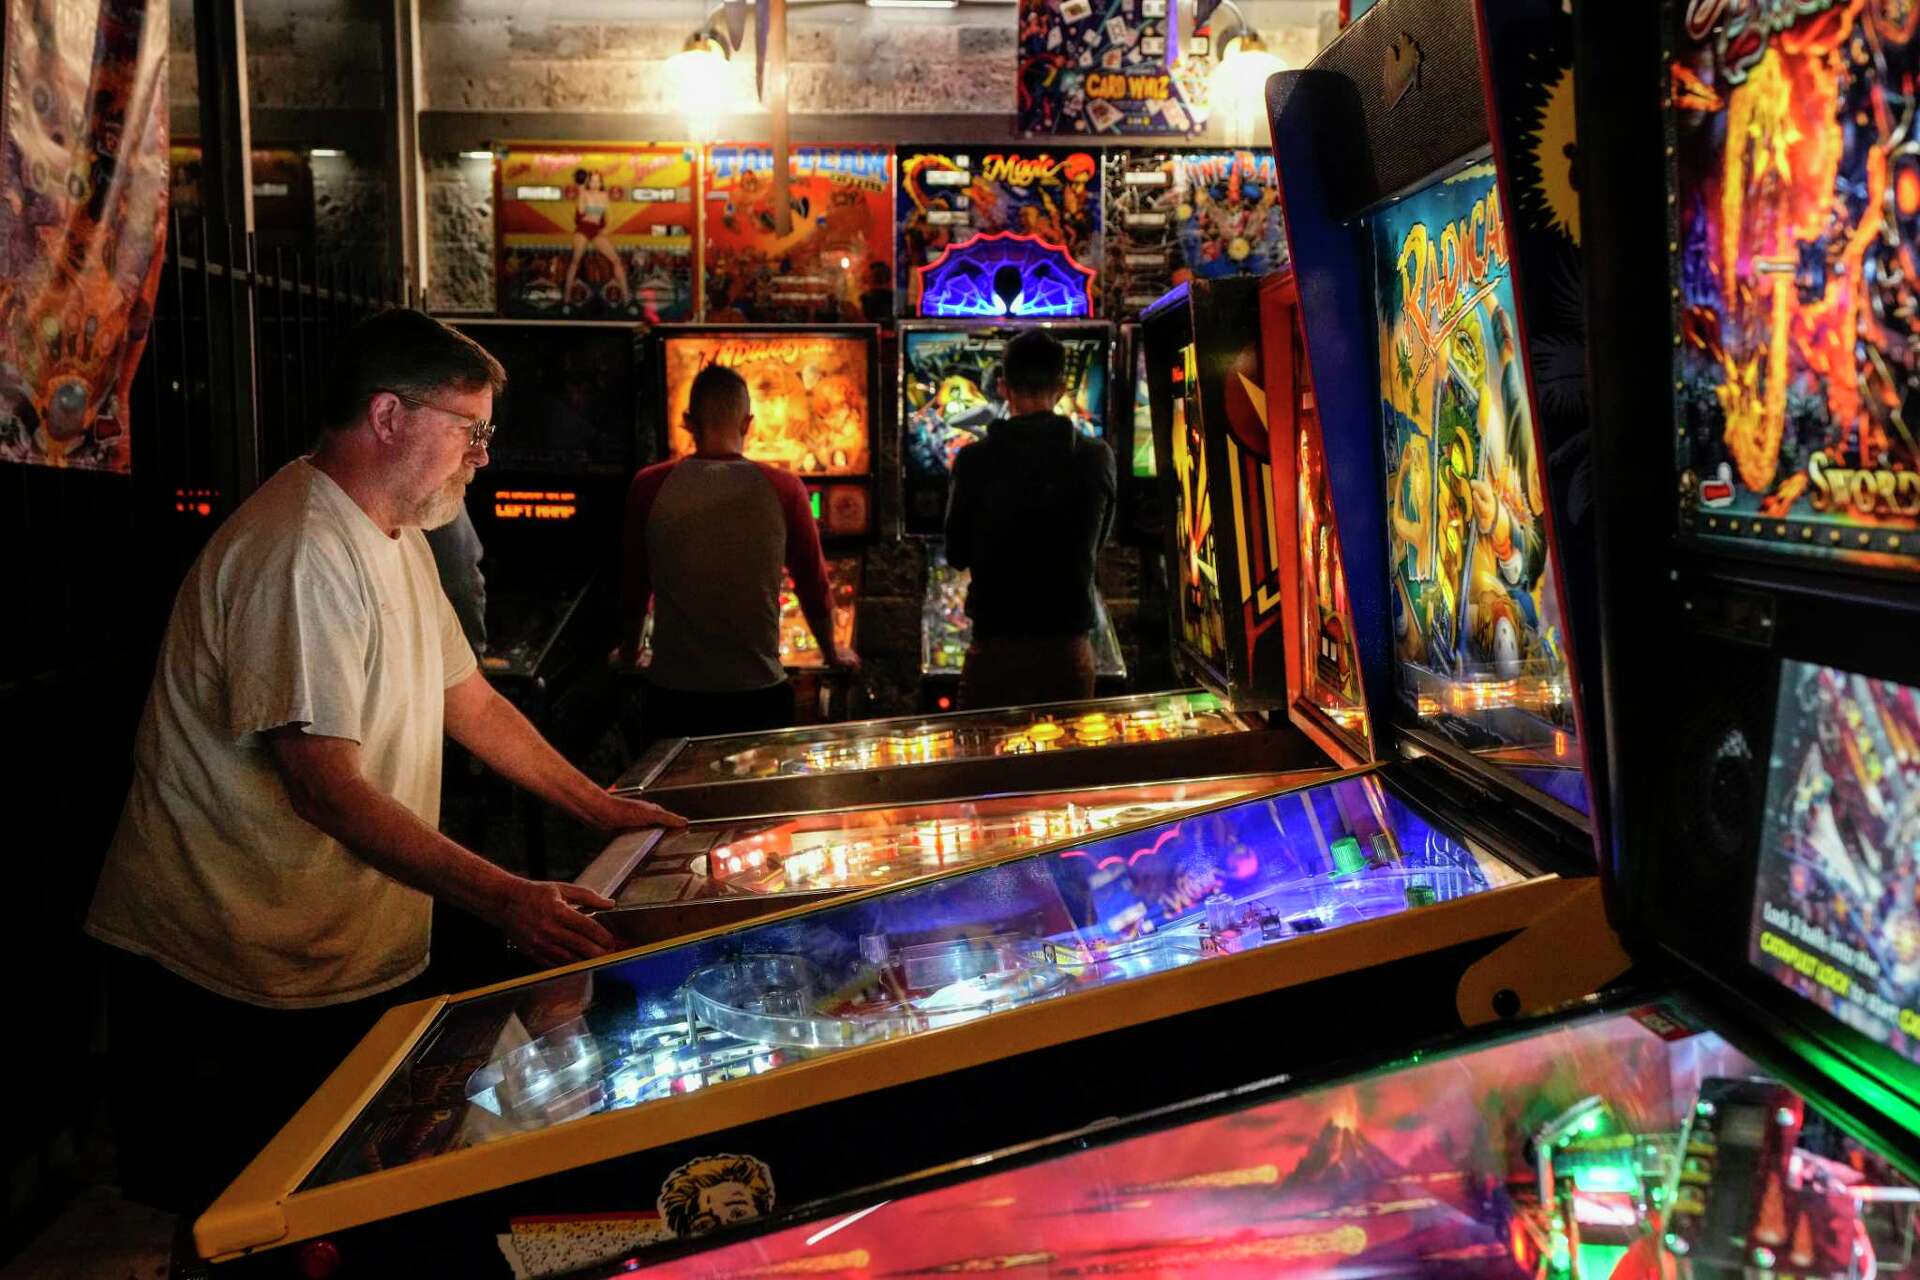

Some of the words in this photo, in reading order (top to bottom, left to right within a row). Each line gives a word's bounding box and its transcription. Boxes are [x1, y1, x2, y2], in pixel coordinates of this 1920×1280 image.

[1086, 73, 1126, 99] CARD
[1128, 75, 1169, 99] WHIZ
[797, 147, 890, 182] TEAM
[981, 153, 1058, 186] Magic
[495, 504, 532, 518] LEFT
[535, 504, 577, 518] RAMP
